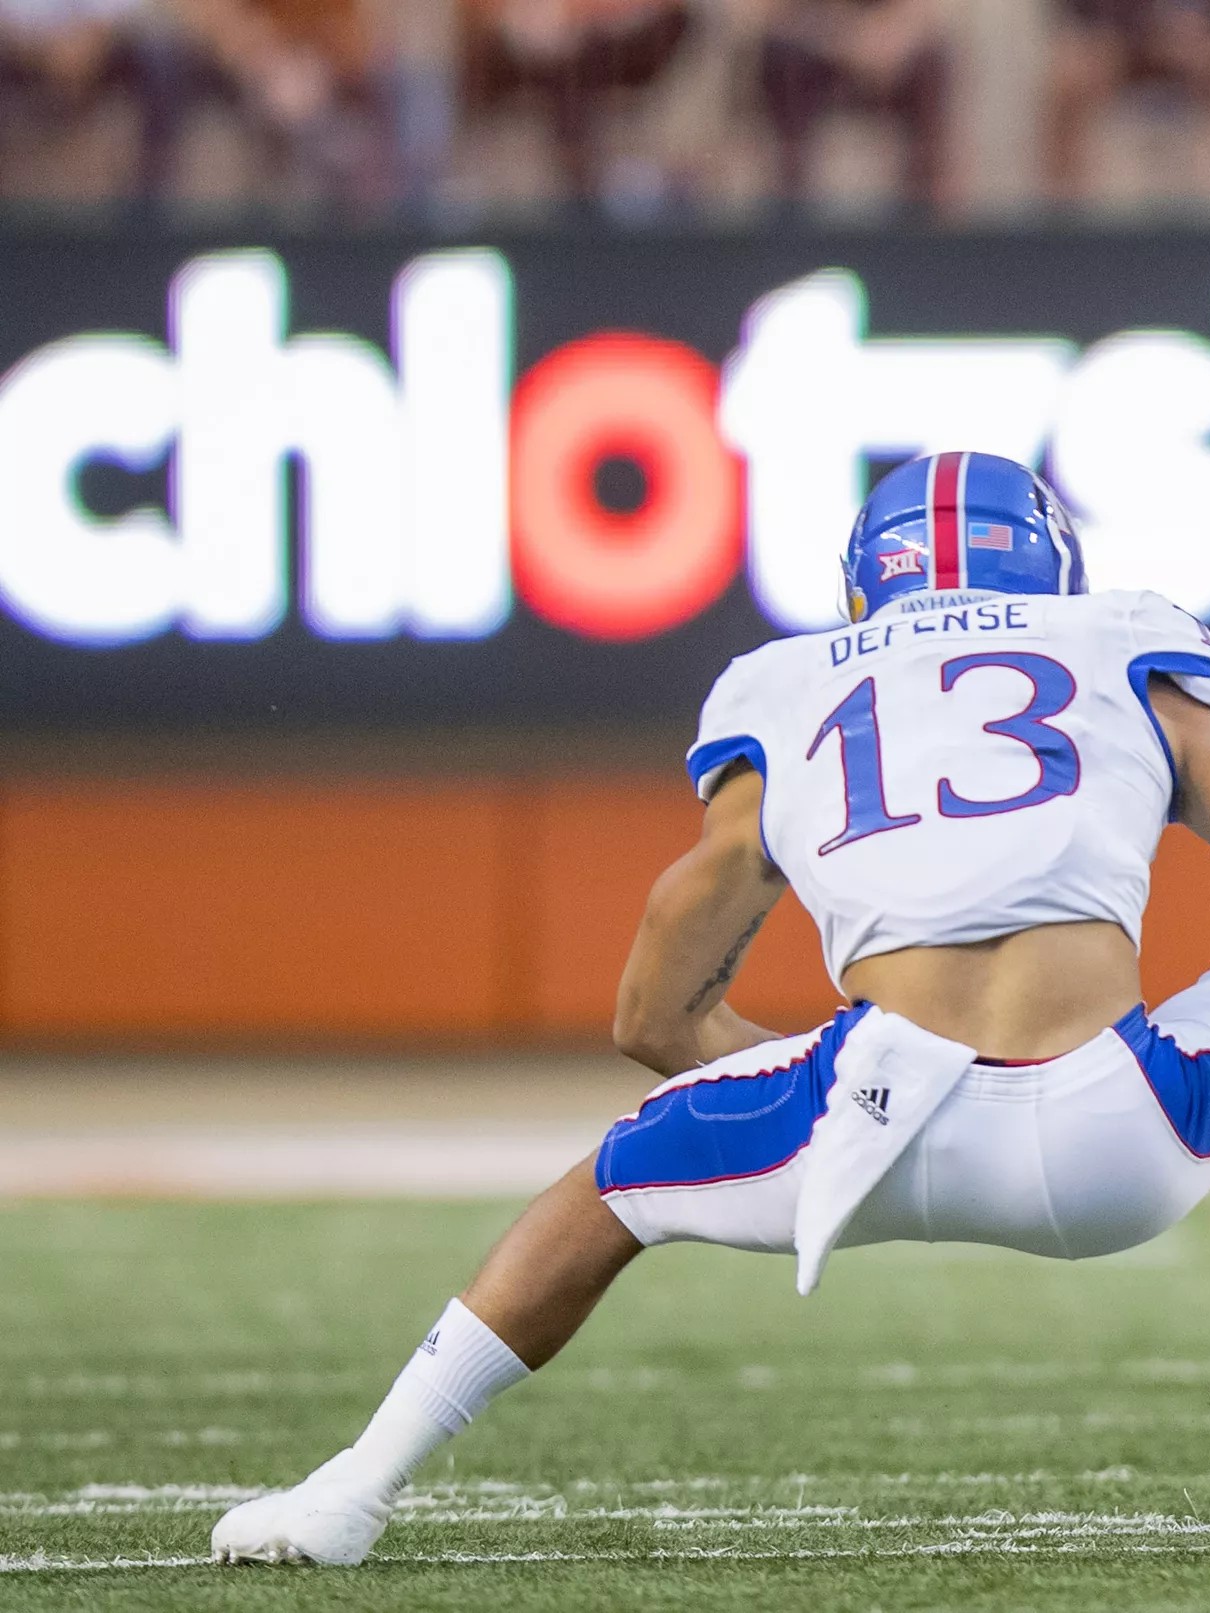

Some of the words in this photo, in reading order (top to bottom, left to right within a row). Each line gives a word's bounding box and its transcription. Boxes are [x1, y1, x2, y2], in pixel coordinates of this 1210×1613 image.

[879, 549, 924, 583] XII
[830, 602, 1029, 667] DEFENSE
[806, 651, 1081, 857] 13
